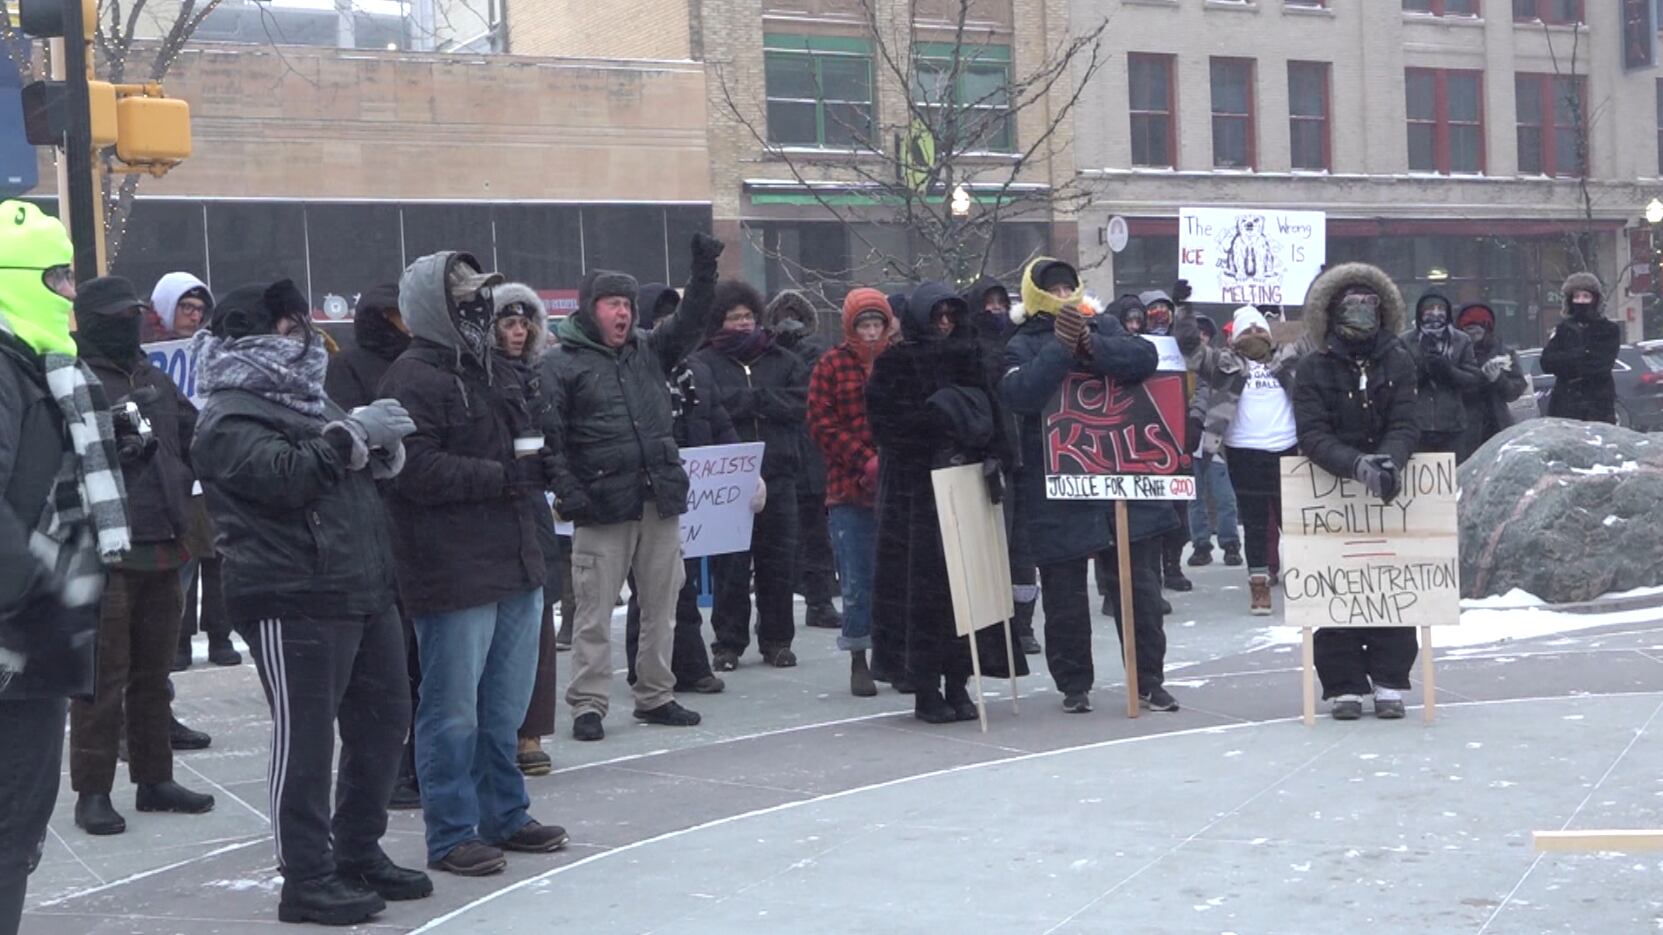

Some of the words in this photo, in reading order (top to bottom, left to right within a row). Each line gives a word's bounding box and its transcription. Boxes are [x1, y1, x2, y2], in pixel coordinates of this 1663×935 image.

[1184, 216, 1213, 236] The
[1277, 216, 1312, 239] Wrong
[1181, 247, 1205, 266] ICE
[1291, 243, 1305, 263] IS
[1222, 284, 1282, 304] MELTING
[1048, 371, 1134, 425] ICE
[688, 455, 757, 480] RACISTS
[1291, 457, 1454, 499] DETION
[1104, 476, 1127, 498] FOR
[1302, 499, 1413, 536] FACILITY
[1283, 557, 1457, 601] CONCENTRATION
[1328, 591, 1418, 624] CAMP
